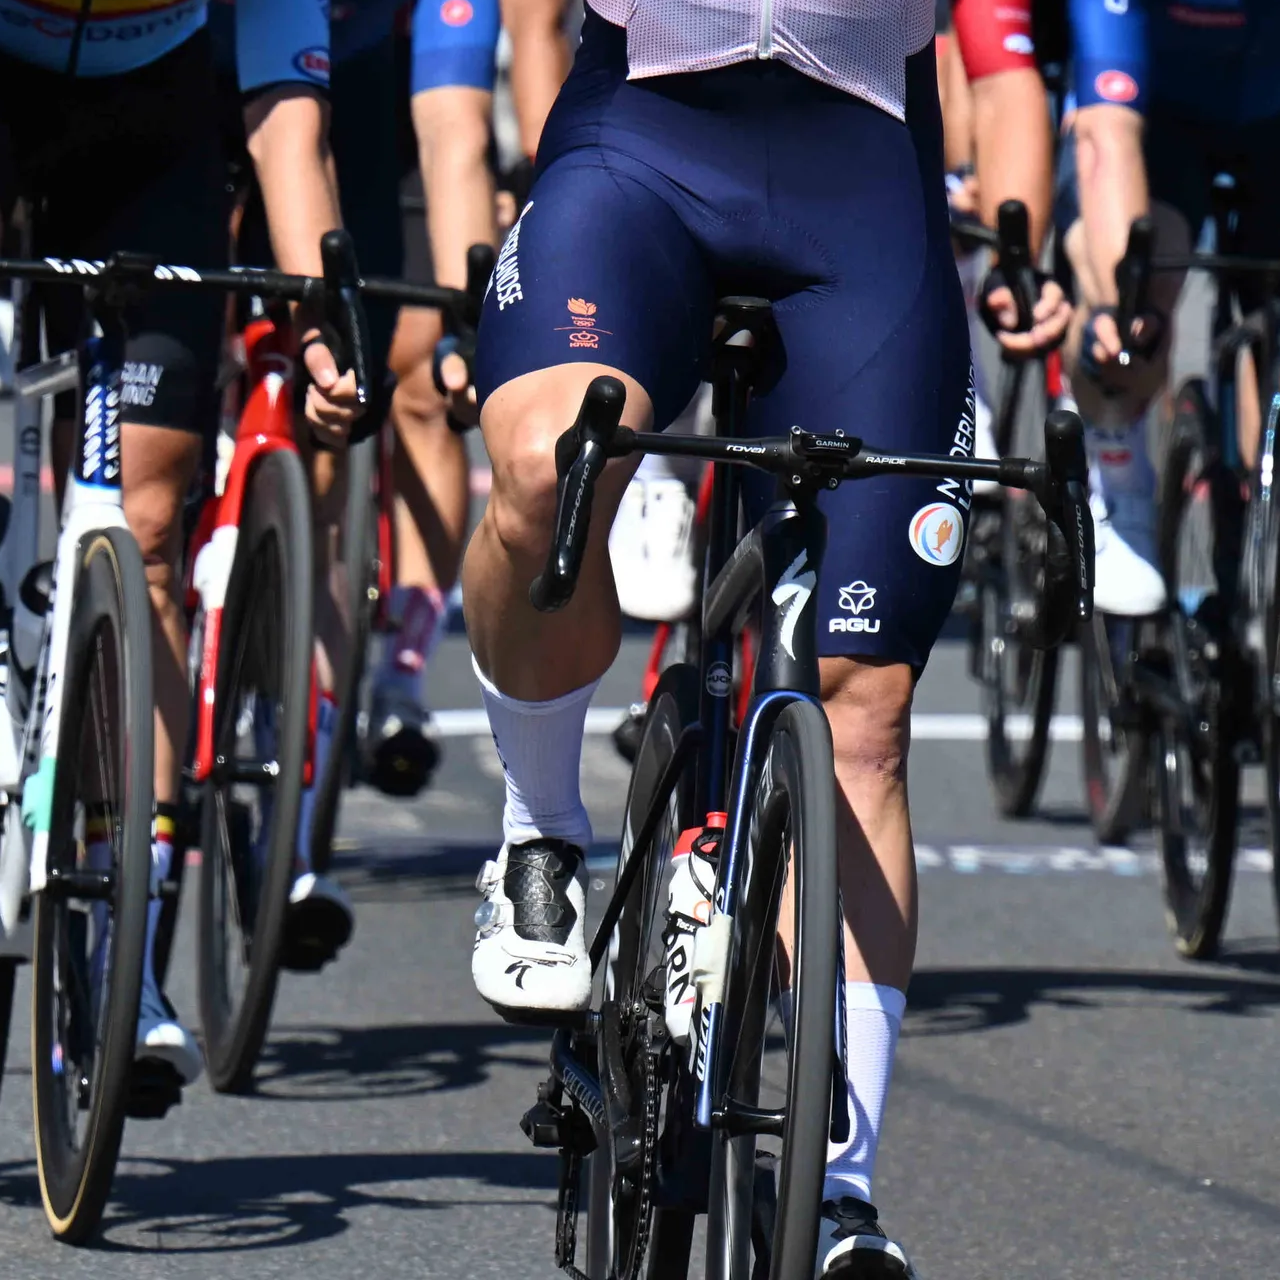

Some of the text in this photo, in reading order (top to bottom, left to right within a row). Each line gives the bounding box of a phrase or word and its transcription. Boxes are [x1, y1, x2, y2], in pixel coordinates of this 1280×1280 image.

[815, 439, 850, 449] GARMIN
[865, 456, 907, 466] RAPIDE
[829, 618, 881, 633] AGU
[676, 917, 697, 933] Tacx
